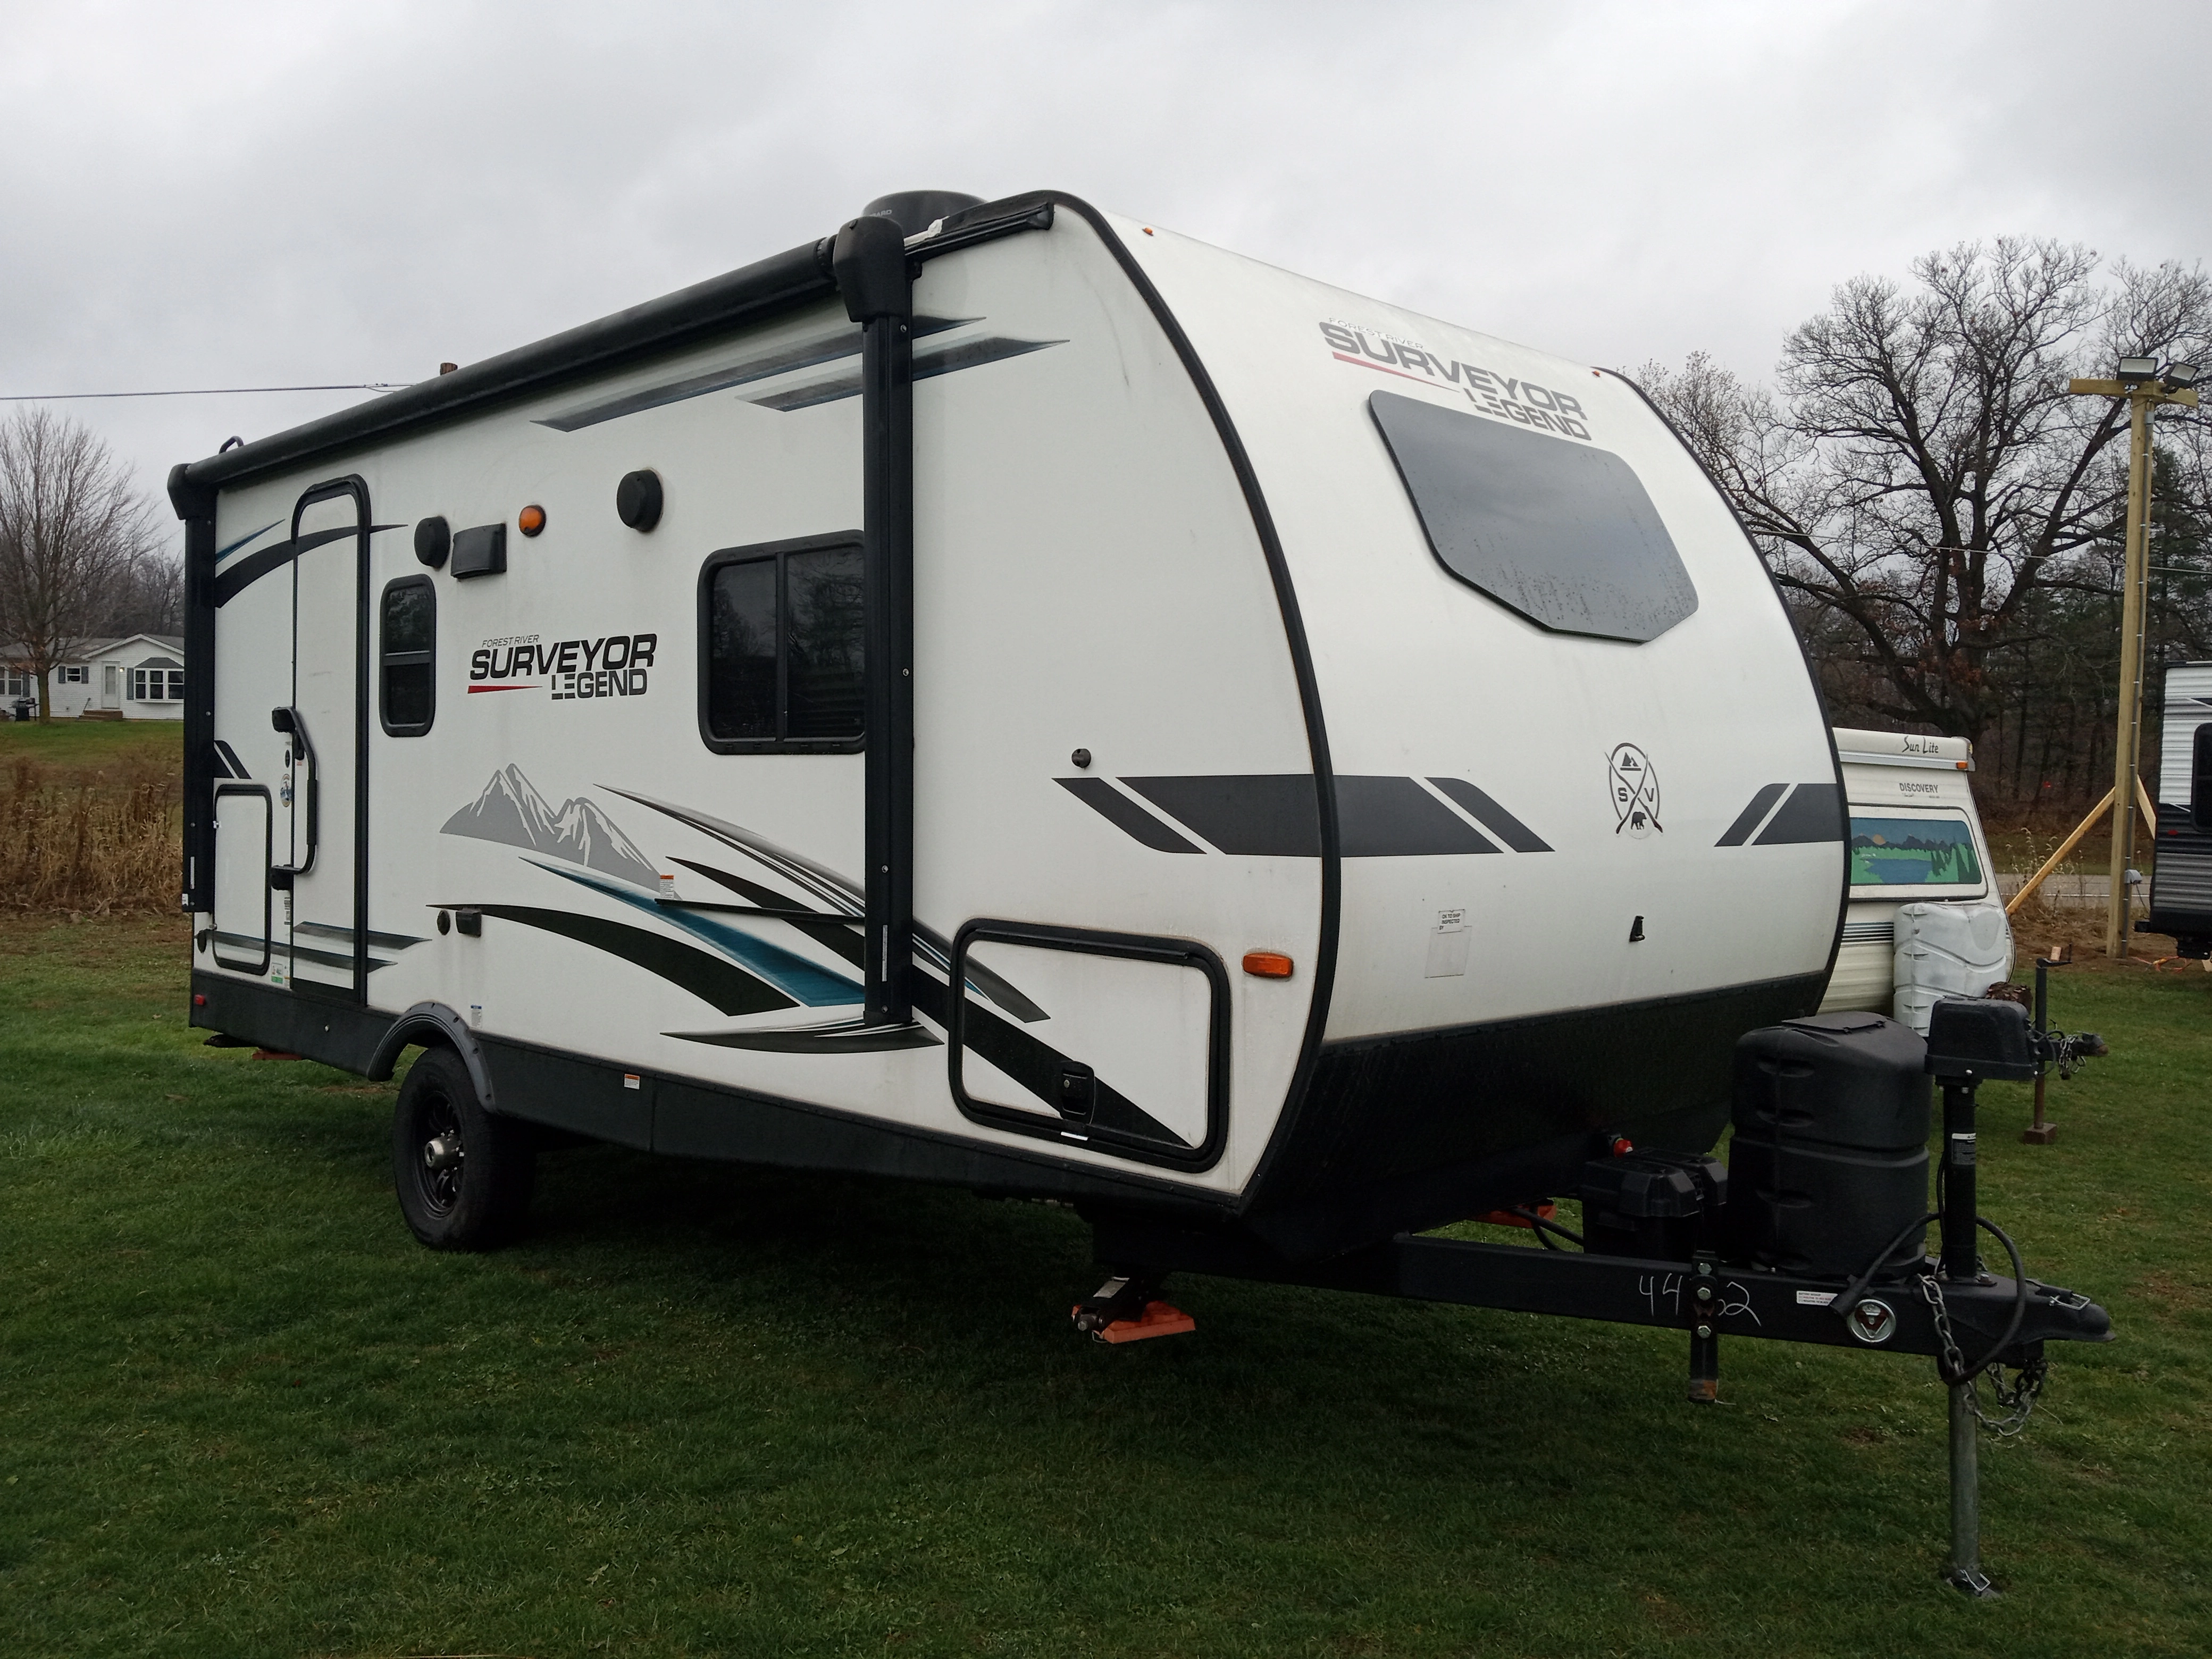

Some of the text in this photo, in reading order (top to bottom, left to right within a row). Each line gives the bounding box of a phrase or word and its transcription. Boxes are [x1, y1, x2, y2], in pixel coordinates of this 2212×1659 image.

[1329, 317, 1423, 349] FOREST RIVER
[1319, 321, 1588, 421] SURVEYOR
[1463, 387, 1592, 441] LEGEND
[470, 633, 657, 680] SURVEYOR
[482, 634, 539, 648] FOREST RIVER
[551, 668, 648, 700] LEGEND
[1901, 735, 1939, 754] Sun Lite
[1618, 787, 1654, 802] S V
[1899, 783, 1938, 793] DISCOVERY
